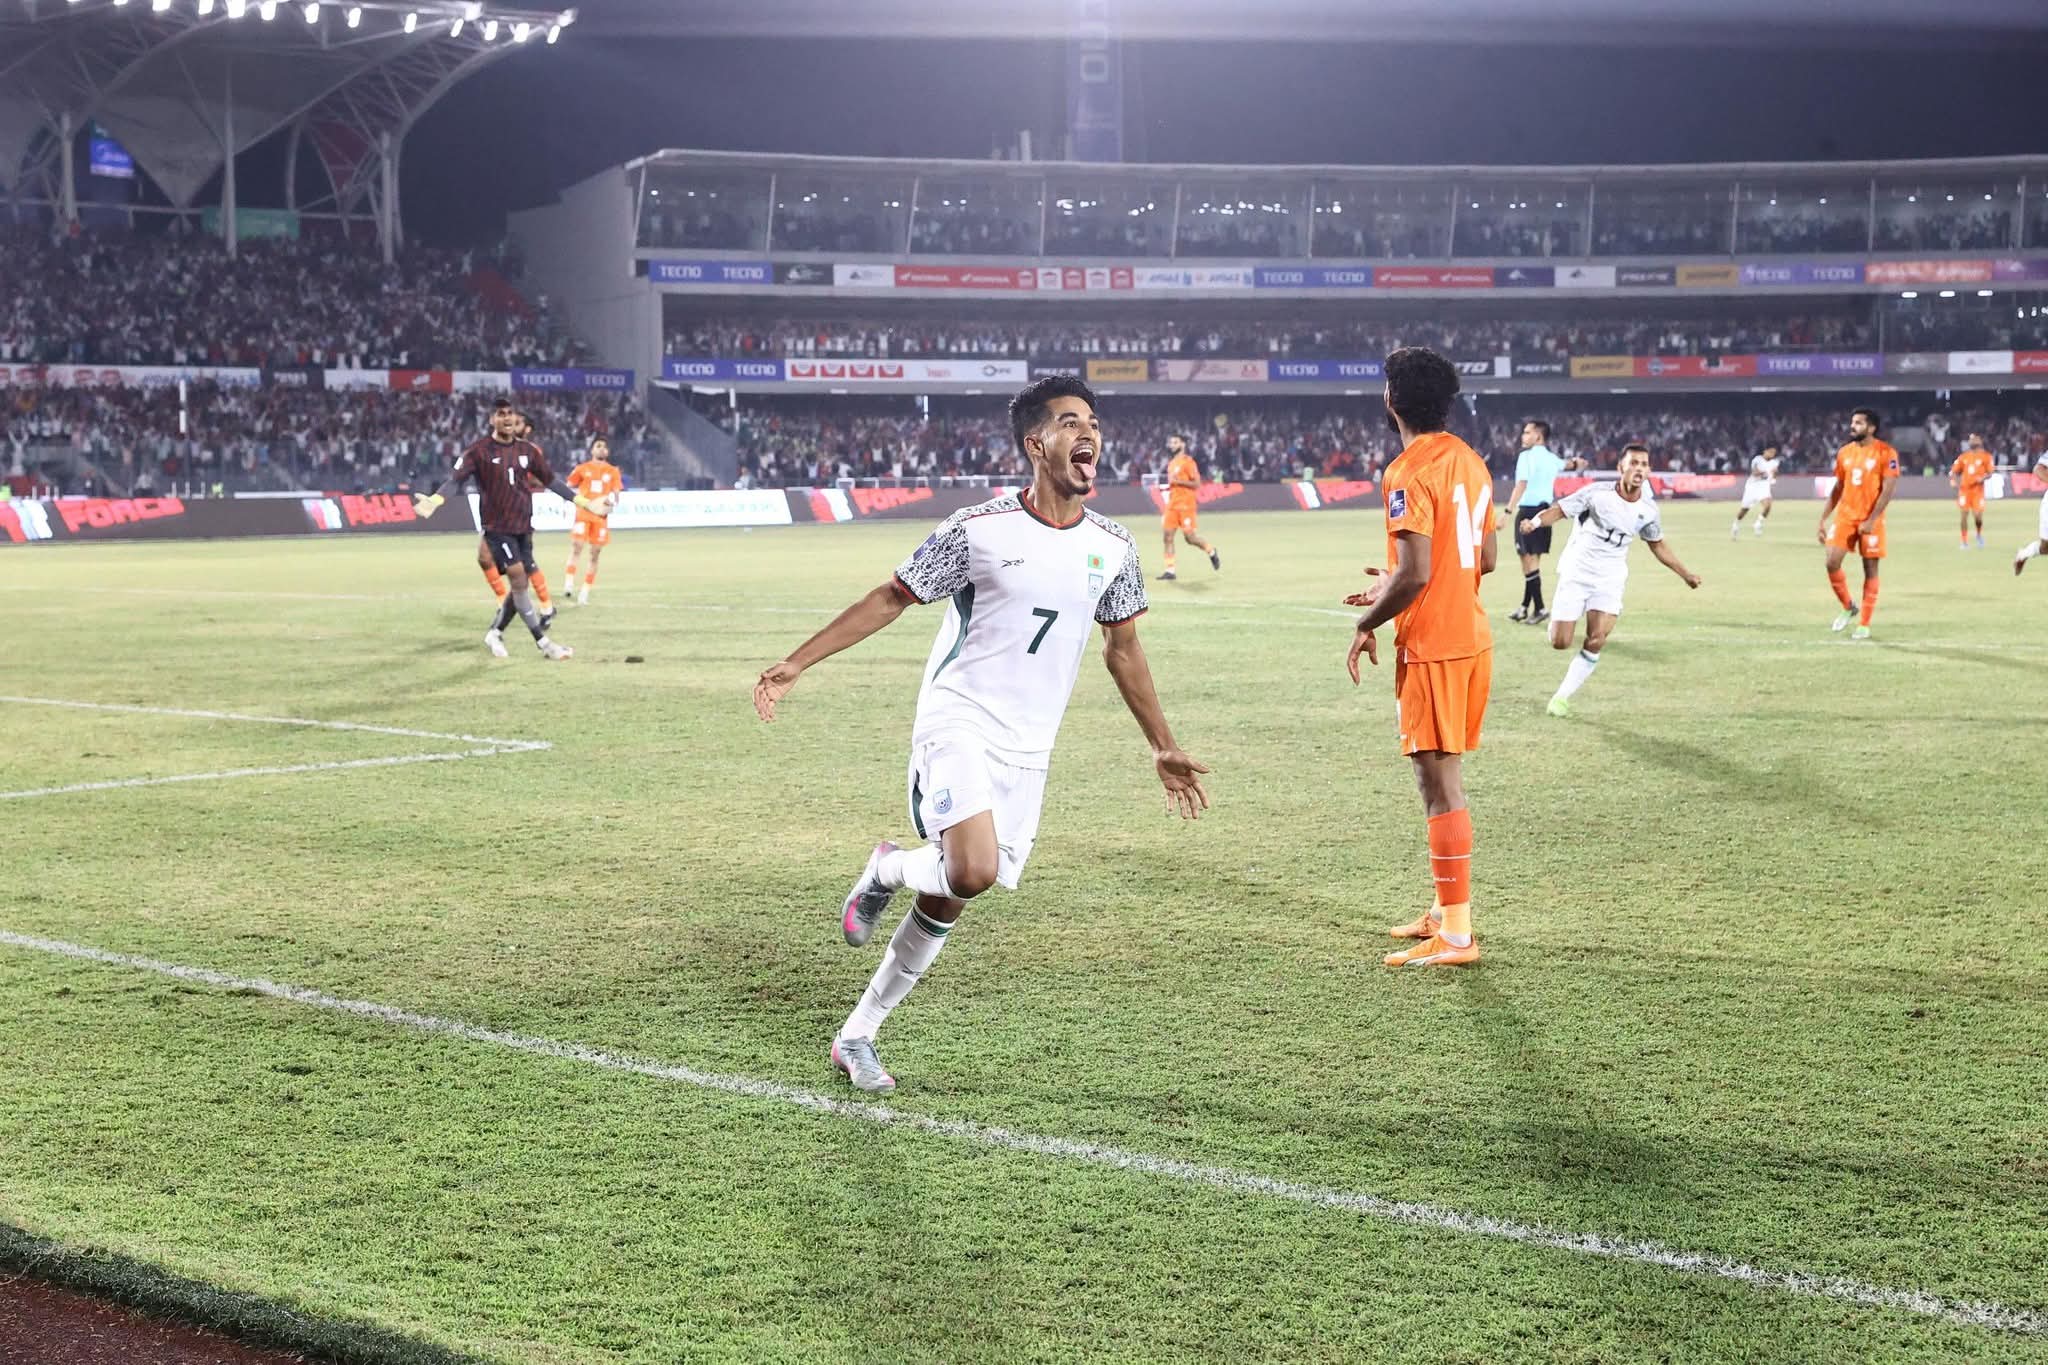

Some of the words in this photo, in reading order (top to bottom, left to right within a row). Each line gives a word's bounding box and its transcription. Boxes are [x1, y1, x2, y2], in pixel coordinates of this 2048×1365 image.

[660, 265, 702, 279] TECNO
[722, 266, 764, 281] TECNO
[1263, 271, 1304, 284] TECNO
[1323, 271, 1365, 284] TECNO
[672, 363, 716, 376] TECNO
[734, 363, 777, 376] TECNO
[1278, 364, 1319, 376] TECNO
[1338, 364, 1379, 376] TECNO
[1768, 358, 1810, 370] TECNO
[1831, 358, 1874, 370] TECNO
[521, 373, 562, 386] TECNO
[585, 373, 625, 386] TECNO
[507, 467, 515, 486] 1
[1452, 483, 1491, 569] 14
[1026, 607, 1059, 655] 7
